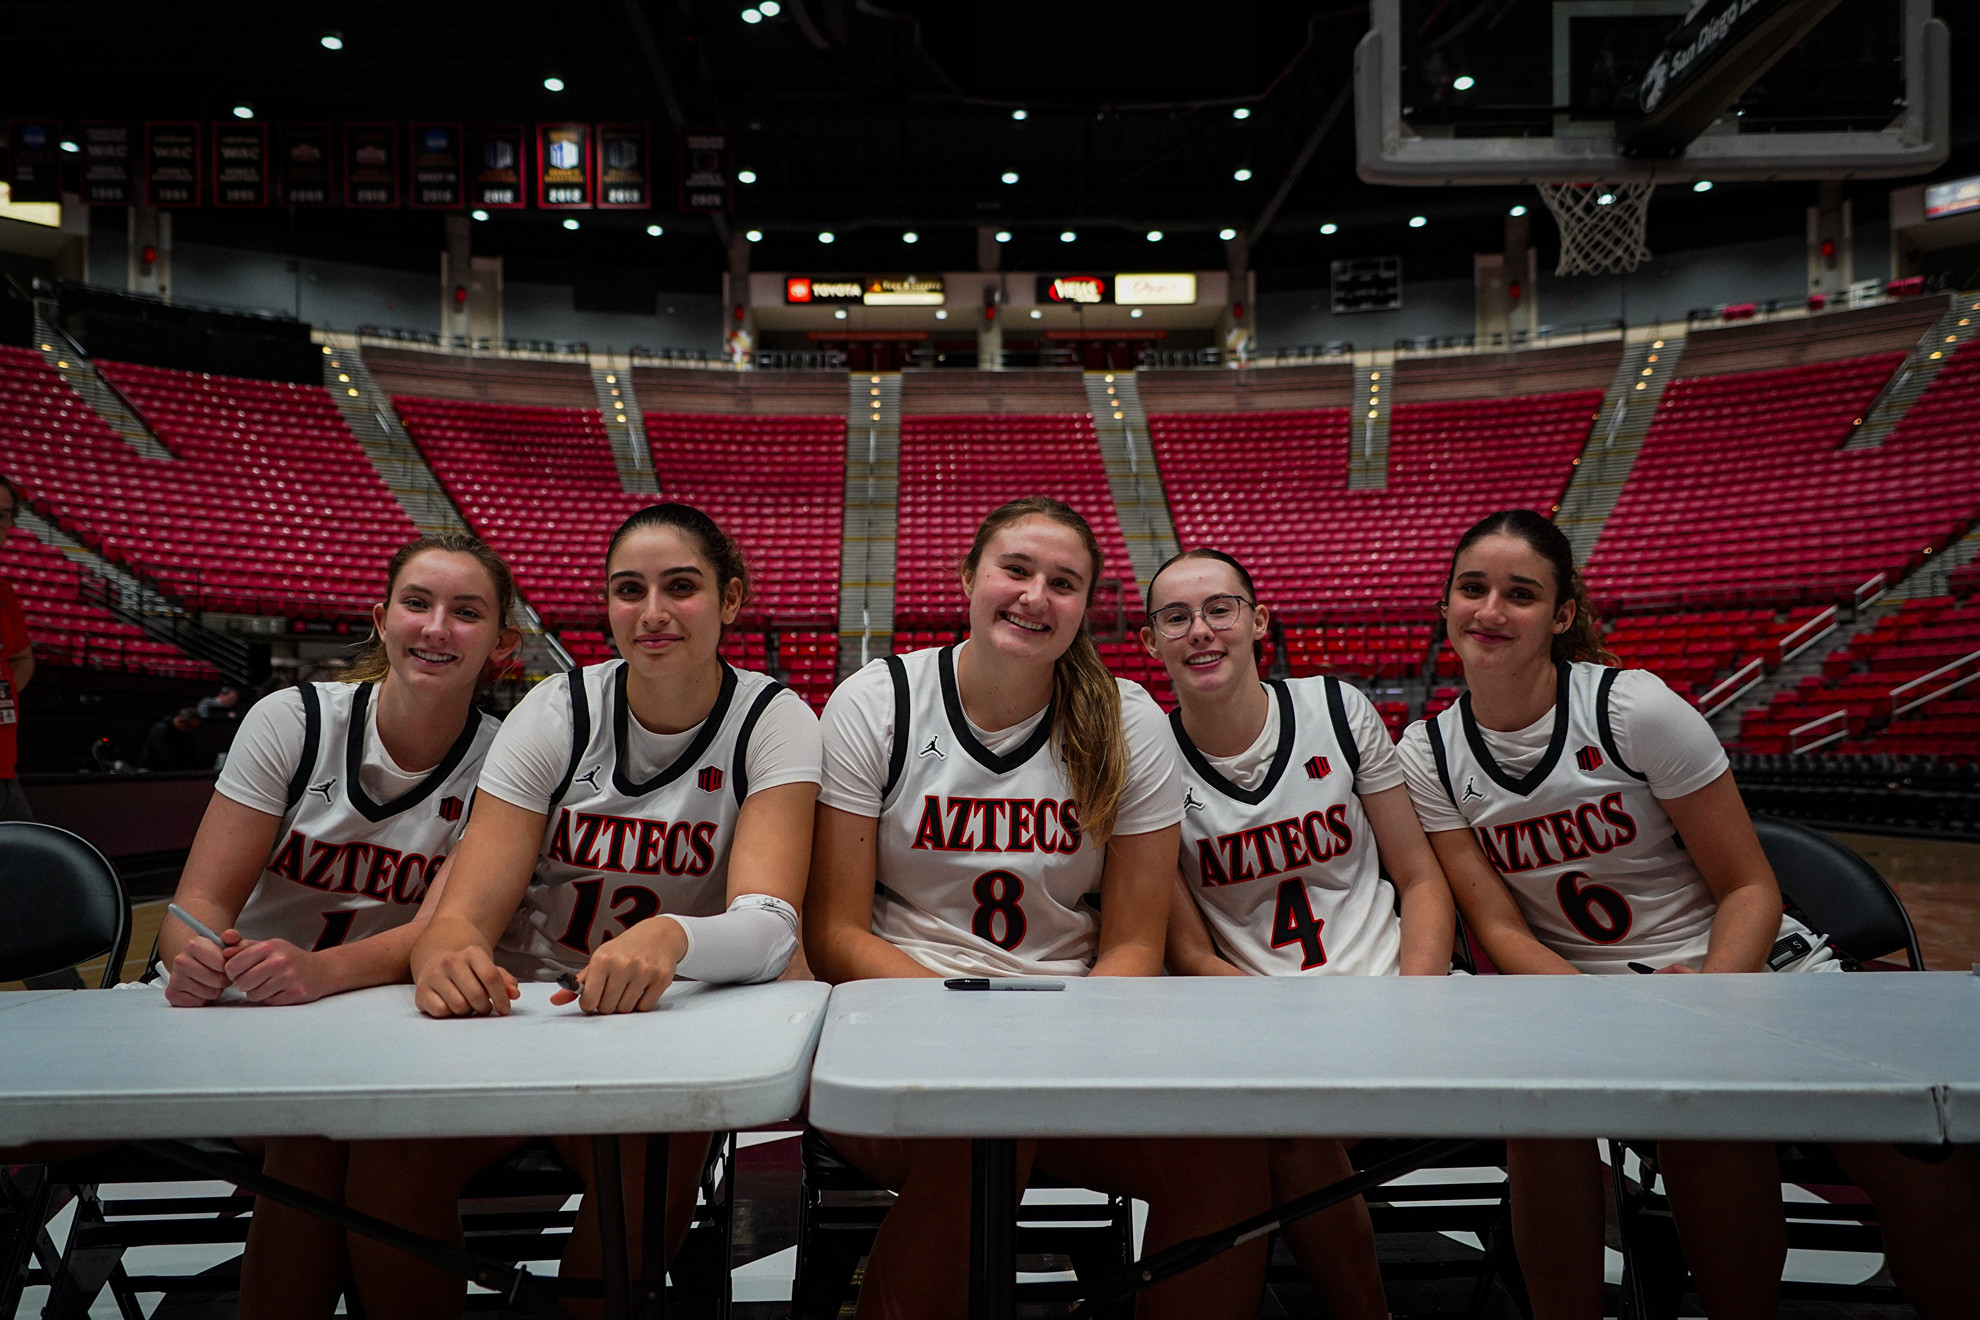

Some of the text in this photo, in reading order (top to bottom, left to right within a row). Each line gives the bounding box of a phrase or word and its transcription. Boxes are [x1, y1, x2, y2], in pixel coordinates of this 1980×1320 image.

[1669, 1, 1739, 78] San Diego
[811, 282, 862, 298] TOYOTA
[547, 808, 718, 877] AZTECS
[911, 795, 1082, 855] AZTECS
[1196, 804, 1353, 887] AZTECS
[1478, 792, 1637, 873] AZTECS
[557, 878, 661, 955] 13
[972, 869, 1027, 952] 8
[1271, 876, 1327, 971] 4
[1556, 871, 1633, 944] 6
